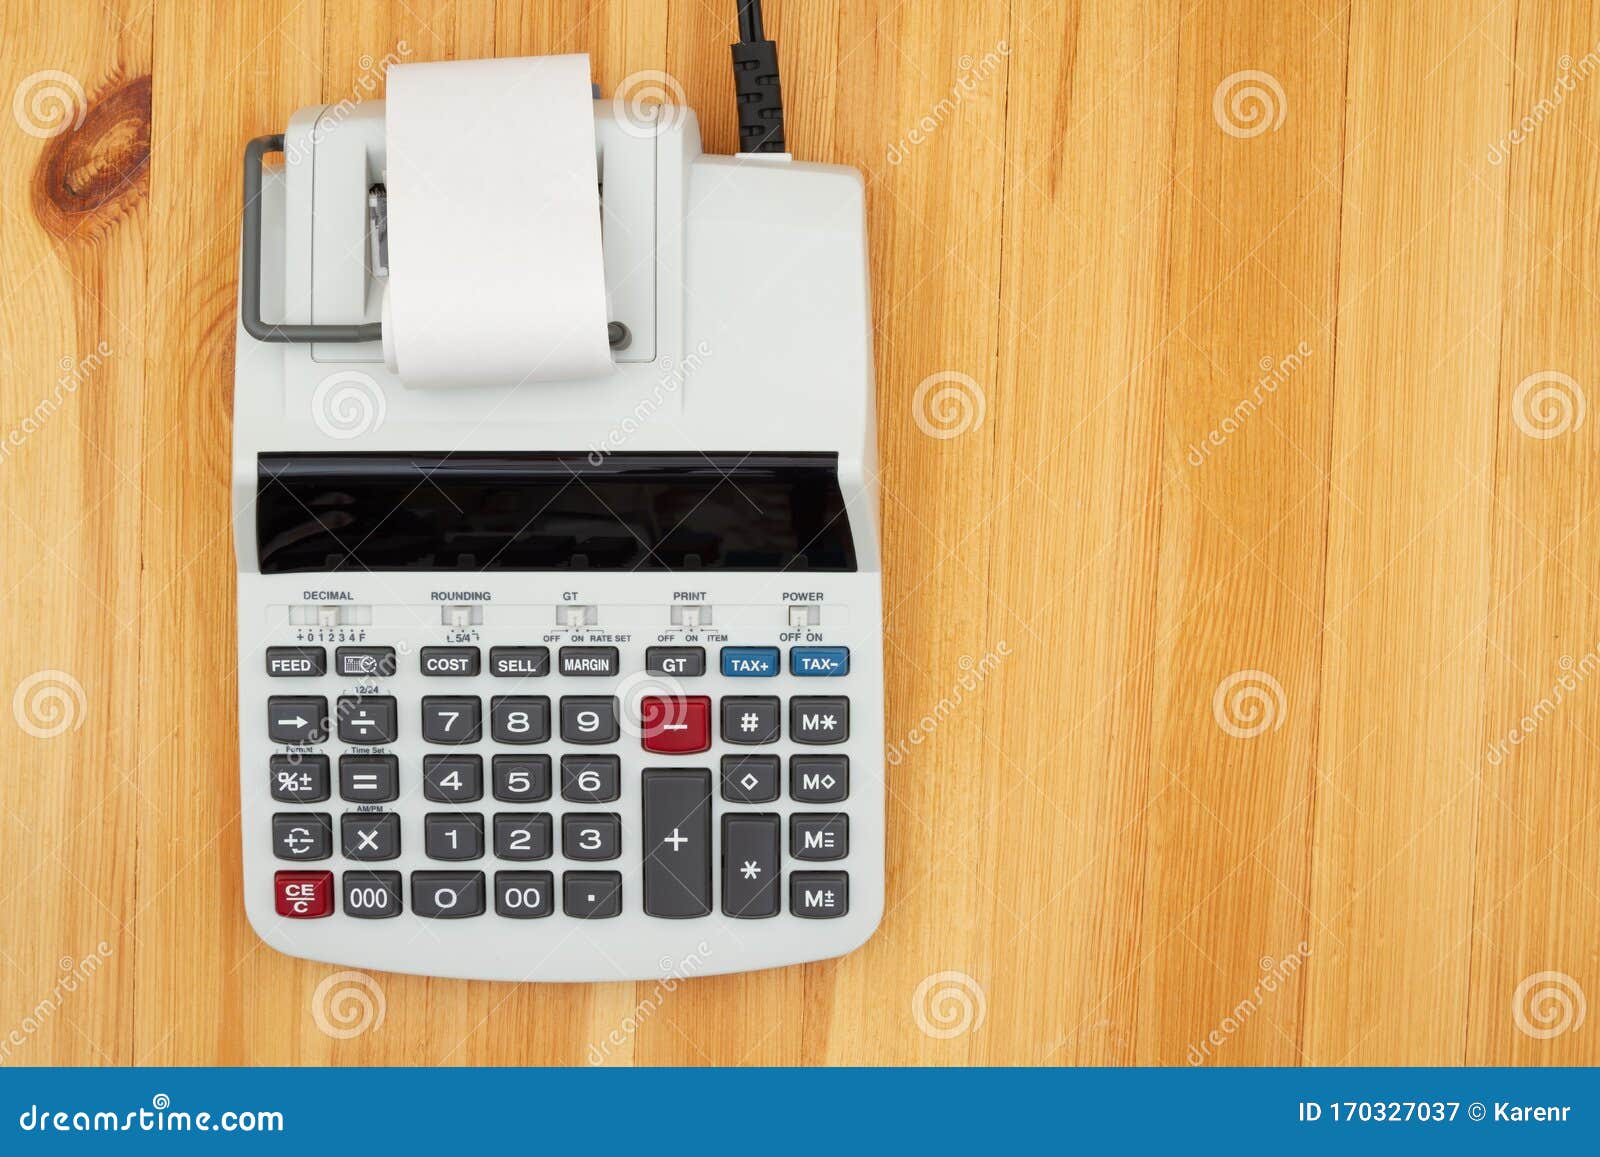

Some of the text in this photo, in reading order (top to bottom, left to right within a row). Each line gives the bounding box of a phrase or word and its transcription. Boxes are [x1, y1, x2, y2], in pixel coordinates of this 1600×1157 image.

[304, 591, 353, 600] DECIMAL
[431, 592, 491, 600] ROUNDING
[563, 592, 577, 600] GT
[674, 592, 706, 600] PRINT
[783, 592, 823, 601] POWER
[308, 633, 314, 641] 0
[319, 633, 323, 641] 1
[329, 633, 334, 641] 2
[339, 634, 345, 642] 3
[359, 634, 365, 642] F
[780, 633, 822, 642] OFF ON
[272, 660, 310, 671] FEED
[427, 659, 468, 670] COST
[499, 660, 536, 672] SELL
[565, 659, 609, 671] MARGIN
[663, 659, 686, 672] GT
[732, 660, 768, 671] TAX+
[354, 686, 379, 694] 12/24
[439, 712, 459, 731] 7
[507, 712, 529, 732] 8
[577, 712, 599, 731] 9
[440, 771, 462, 790] 4
[508, 773, 530, 792] 5
[578, 771, 600, 791] 6
[445, 830, 456, 849] 1
[510, 830, 530, 849] 2
[580, 829, 601, 849] 3
[286, 884, 314, 896] CE
[351, 888, 387, 908] 000
[435, 889, 457, 908] 0
[506, 888, 540, 907] 00
[294, 901, 307, 912] C
